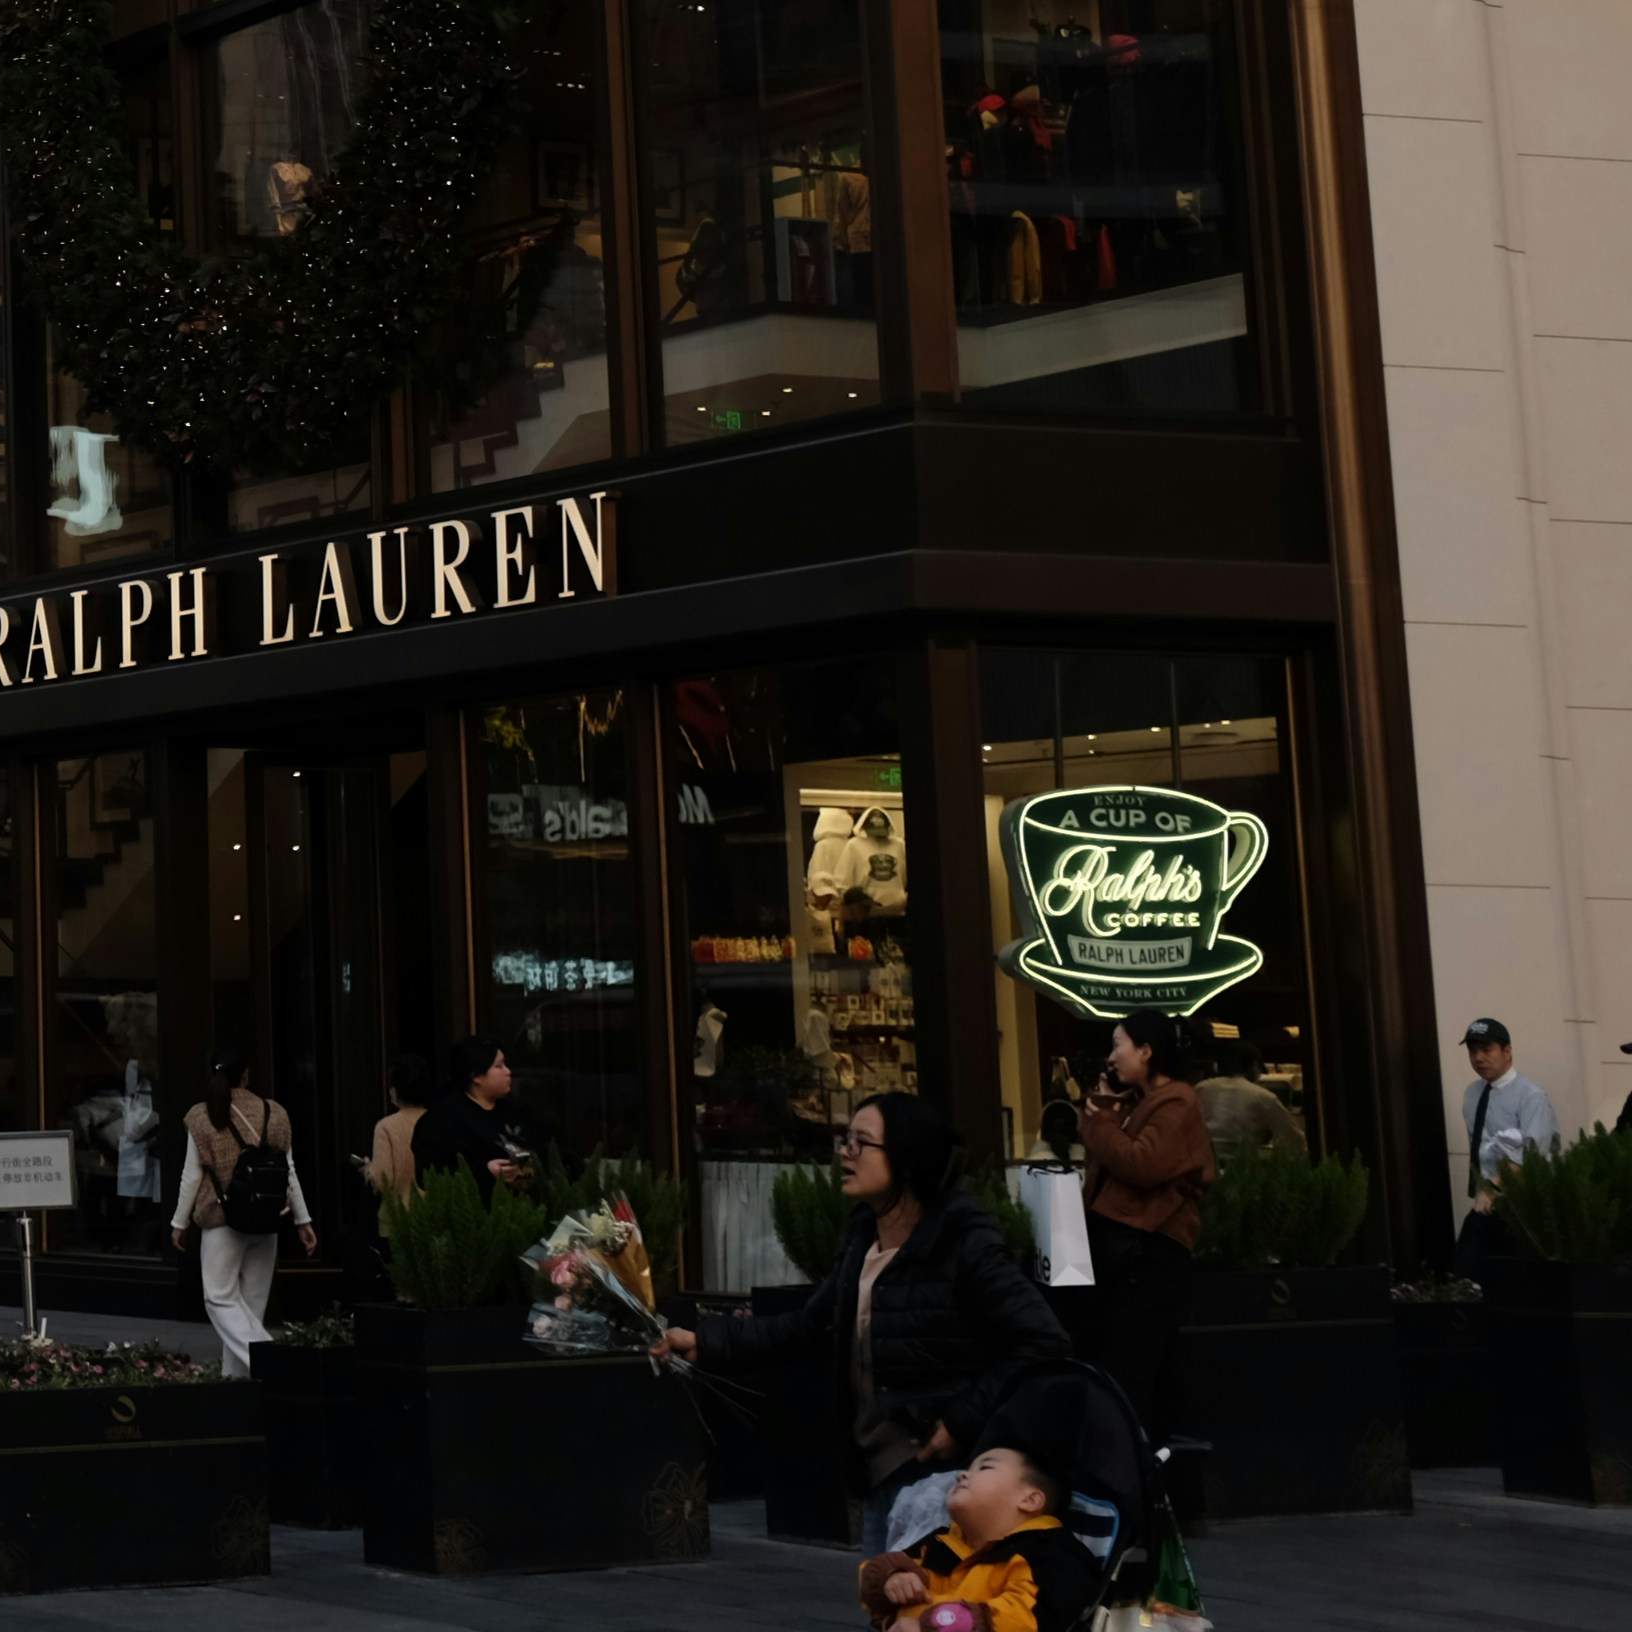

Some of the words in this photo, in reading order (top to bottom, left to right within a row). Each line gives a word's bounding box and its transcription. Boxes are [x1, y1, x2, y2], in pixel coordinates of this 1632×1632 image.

[257, 490, 609, 647] LAUREN
[1093, 794, 1148, 808] ENJOY
[1058, 809, 1080, 829] A
[1089, 807, 1147, 828] CUP
[1154, 811, 1193, 835] OF
[1039, 844, 1203, 937] Ralph's
[1103, 911, 1201, 928] COFFEE
[1078, 942, 1125, 965] RALPH
[1128, 943, 1186, 966] LAUREN
[1079, 983, 1111, 997] NEW
[1114, 985, 1152, 999] YORK
[1155, 985, 1188, 998] CITY
